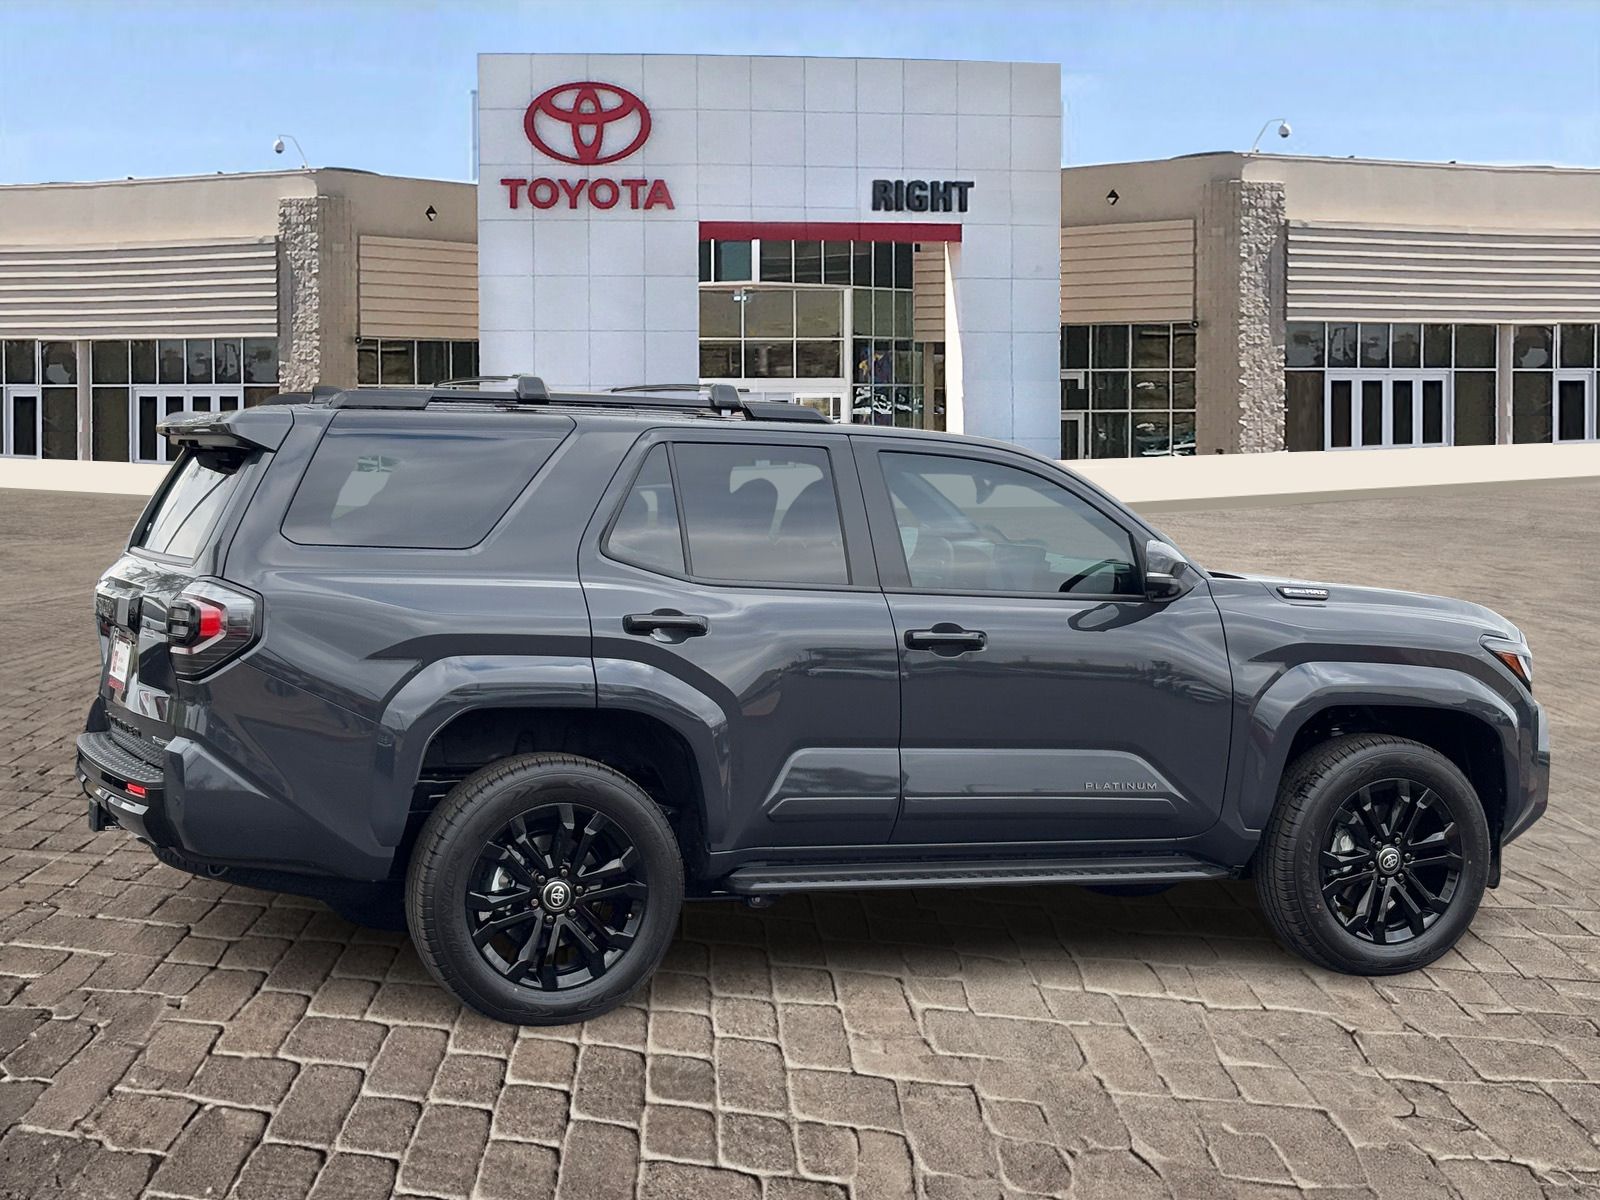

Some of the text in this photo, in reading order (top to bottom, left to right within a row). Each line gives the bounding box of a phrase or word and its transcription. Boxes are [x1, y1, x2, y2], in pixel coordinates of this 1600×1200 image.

[500, 178, 675, 209] TOYOTA
[872, 180, 974, 212] RIGHT
[1084, 782, 1157, 790] PLATINUM
